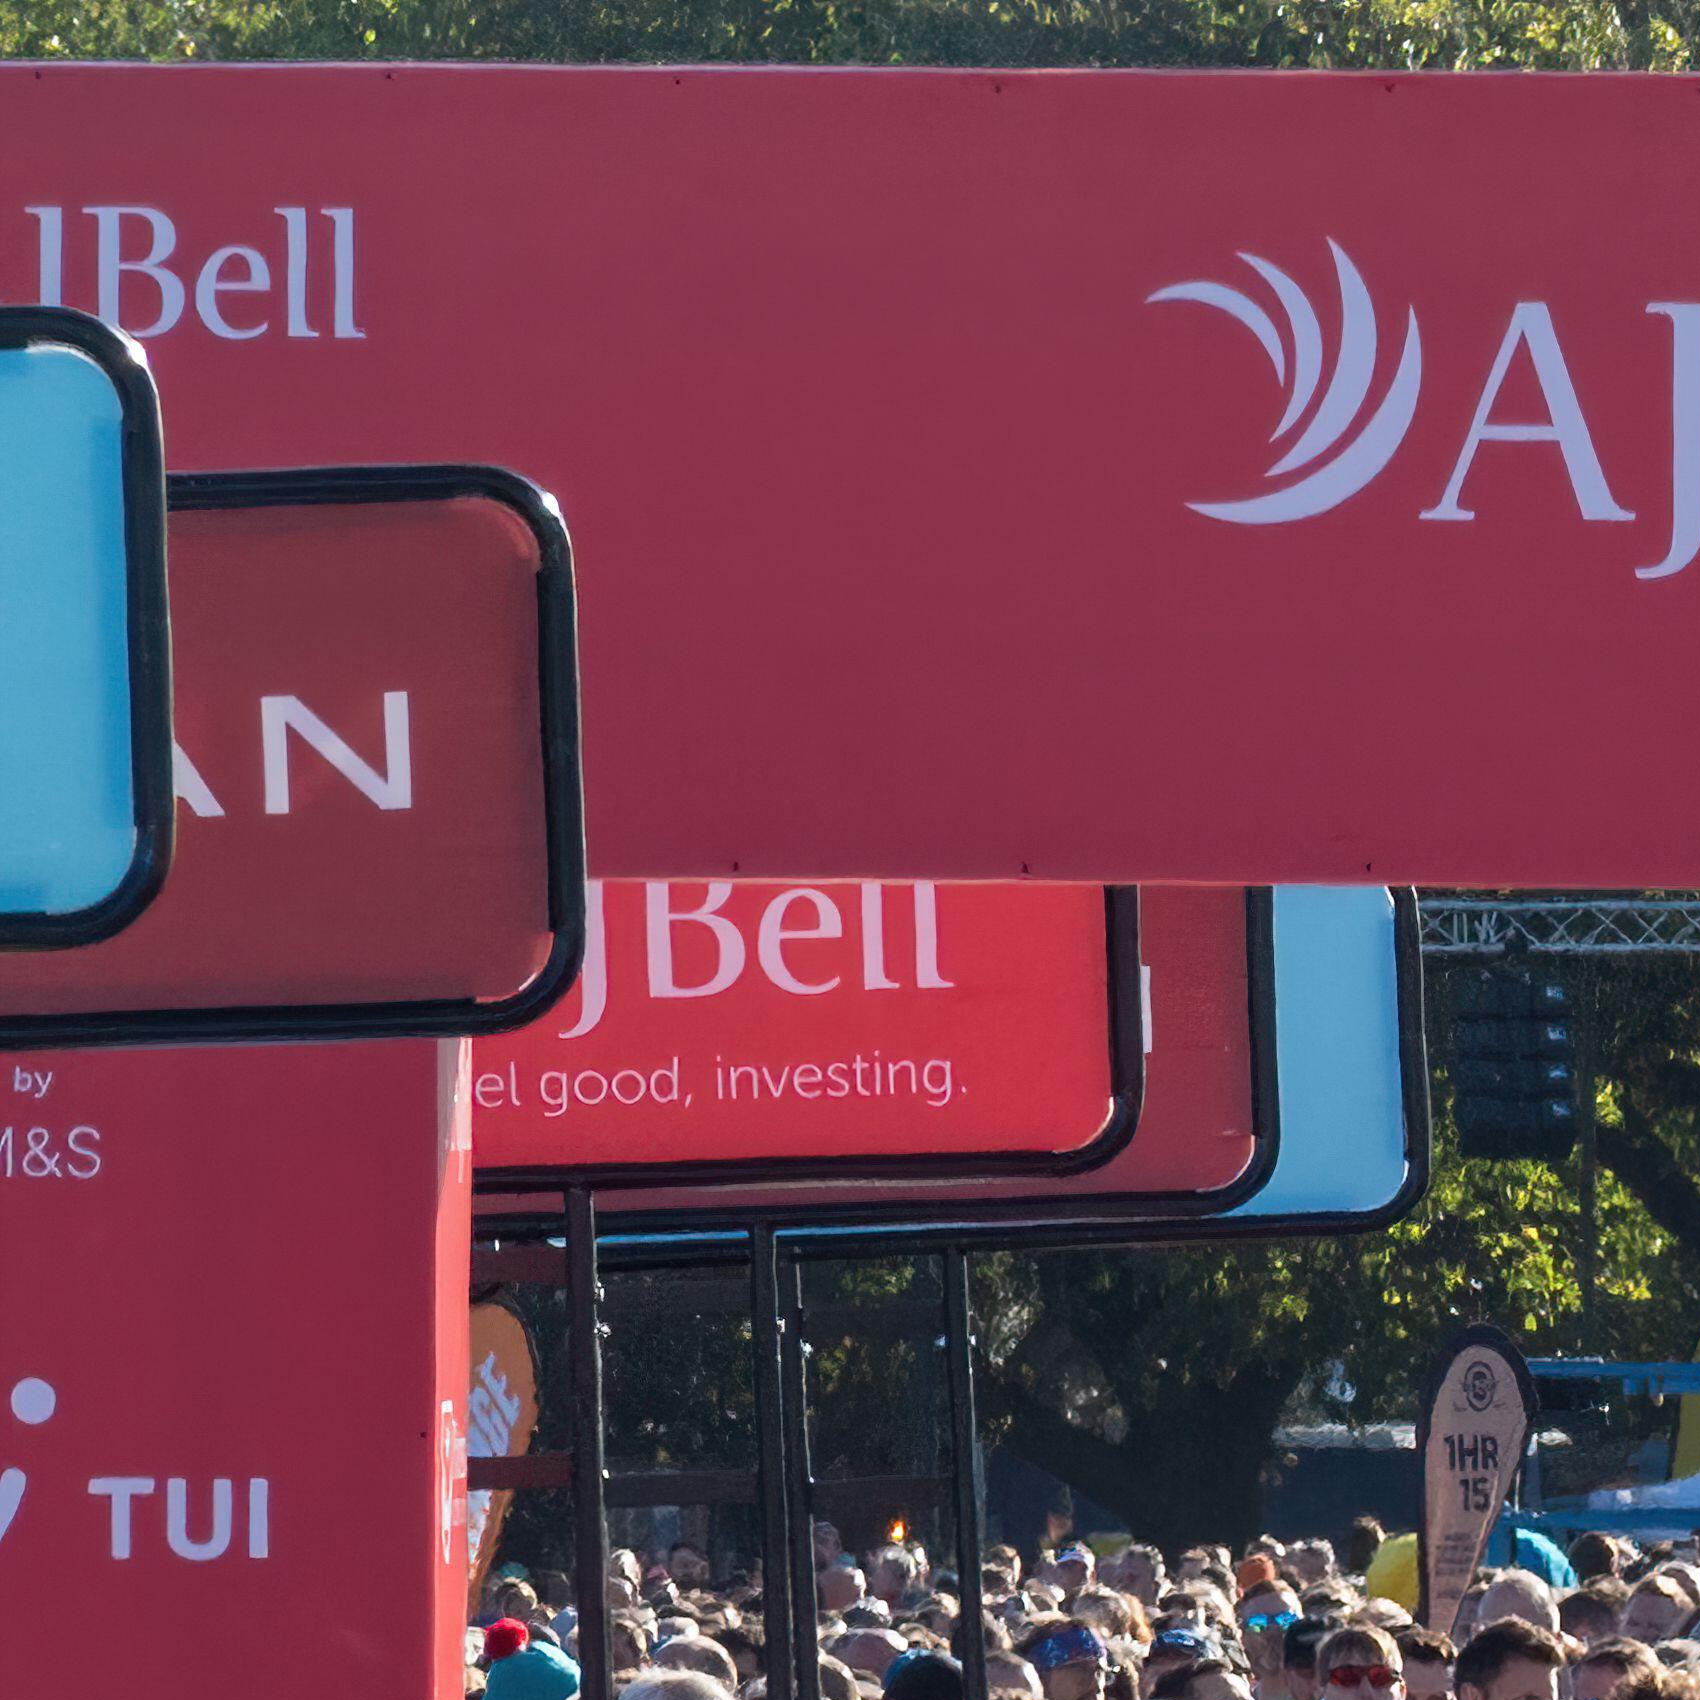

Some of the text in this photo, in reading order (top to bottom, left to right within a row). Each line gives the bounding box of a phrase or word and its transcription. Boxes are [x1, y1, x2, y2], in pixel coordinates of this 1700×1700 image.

[24, 206, 366, 340] JBell
[14, 1065, 53, 1098] by
[475, 1050, 968, 1118] el good, investing.
[1444, 1433, 1499, 1472] 1HR
[88, 1477, 270, 1561] TUI
[1459, 1477, 1490, 1512] 15
